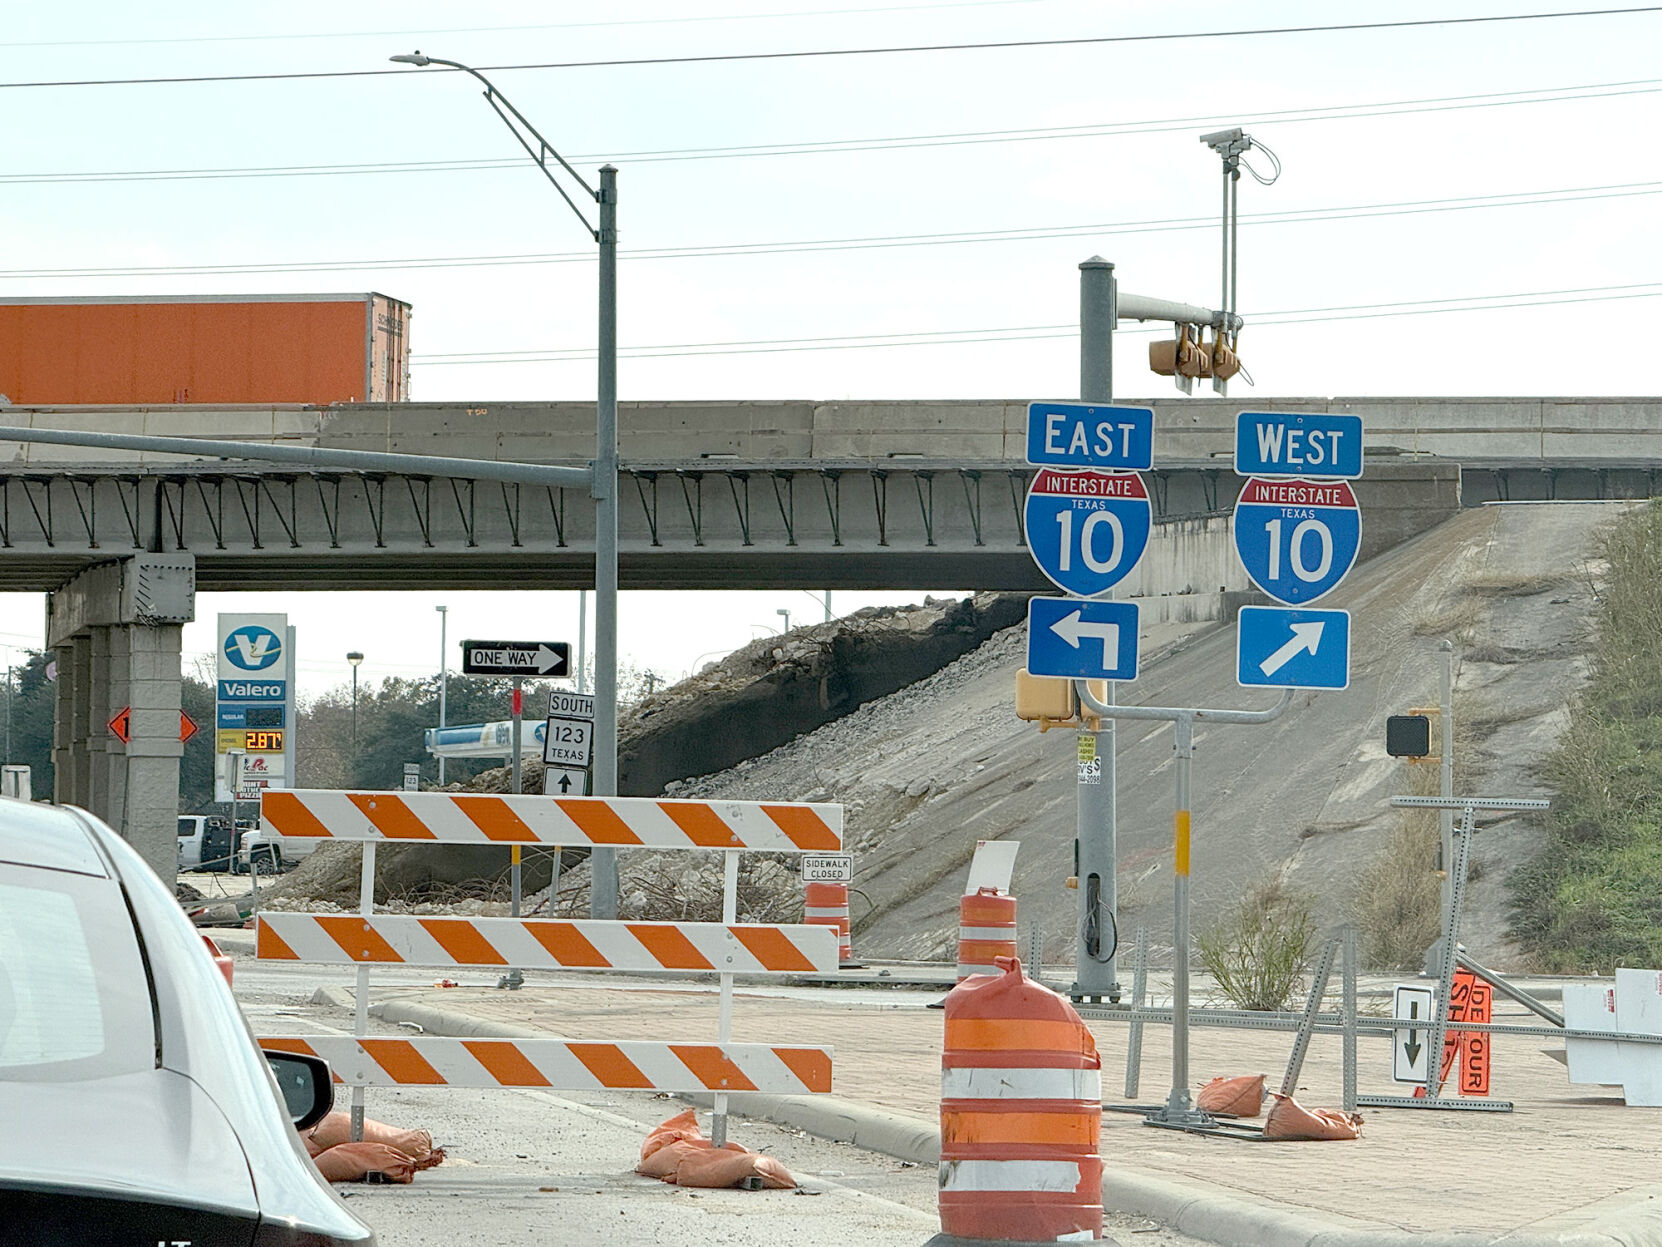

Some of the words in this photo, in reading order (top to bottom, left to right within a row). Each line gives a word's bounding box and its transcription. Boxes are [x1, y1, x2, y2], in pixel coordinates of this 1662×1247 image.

[1044, 413, 1136, 458] EAST
[1256, 423, 1344, 466] WEST
[1045, 475, 1133, 497] INTERSTATE
[1254, 484, 1342, 506] INTERSTATE
[1071, 498, 1107, 511] TEXAS
[1280, 507, 1316, 520] TEXAS
[1055, 509, 1125, 574] 10
[1264, 518, 1334, 583] 10
[474, 650, 503, 665] ONE
[508, 651, 537, 666] WAY
[223, 682, 282, 697] Valero
[551, 695, 593, 714] SOUTH
[554, 726, 585, 744] 123
[551, 747, 584, 761] TEXAS
[806, 860, 848, 868] SIDEWALK
[811, 870, 843, 878] CLOSED
[1468, 989, 1485, 1088] DEOUR
